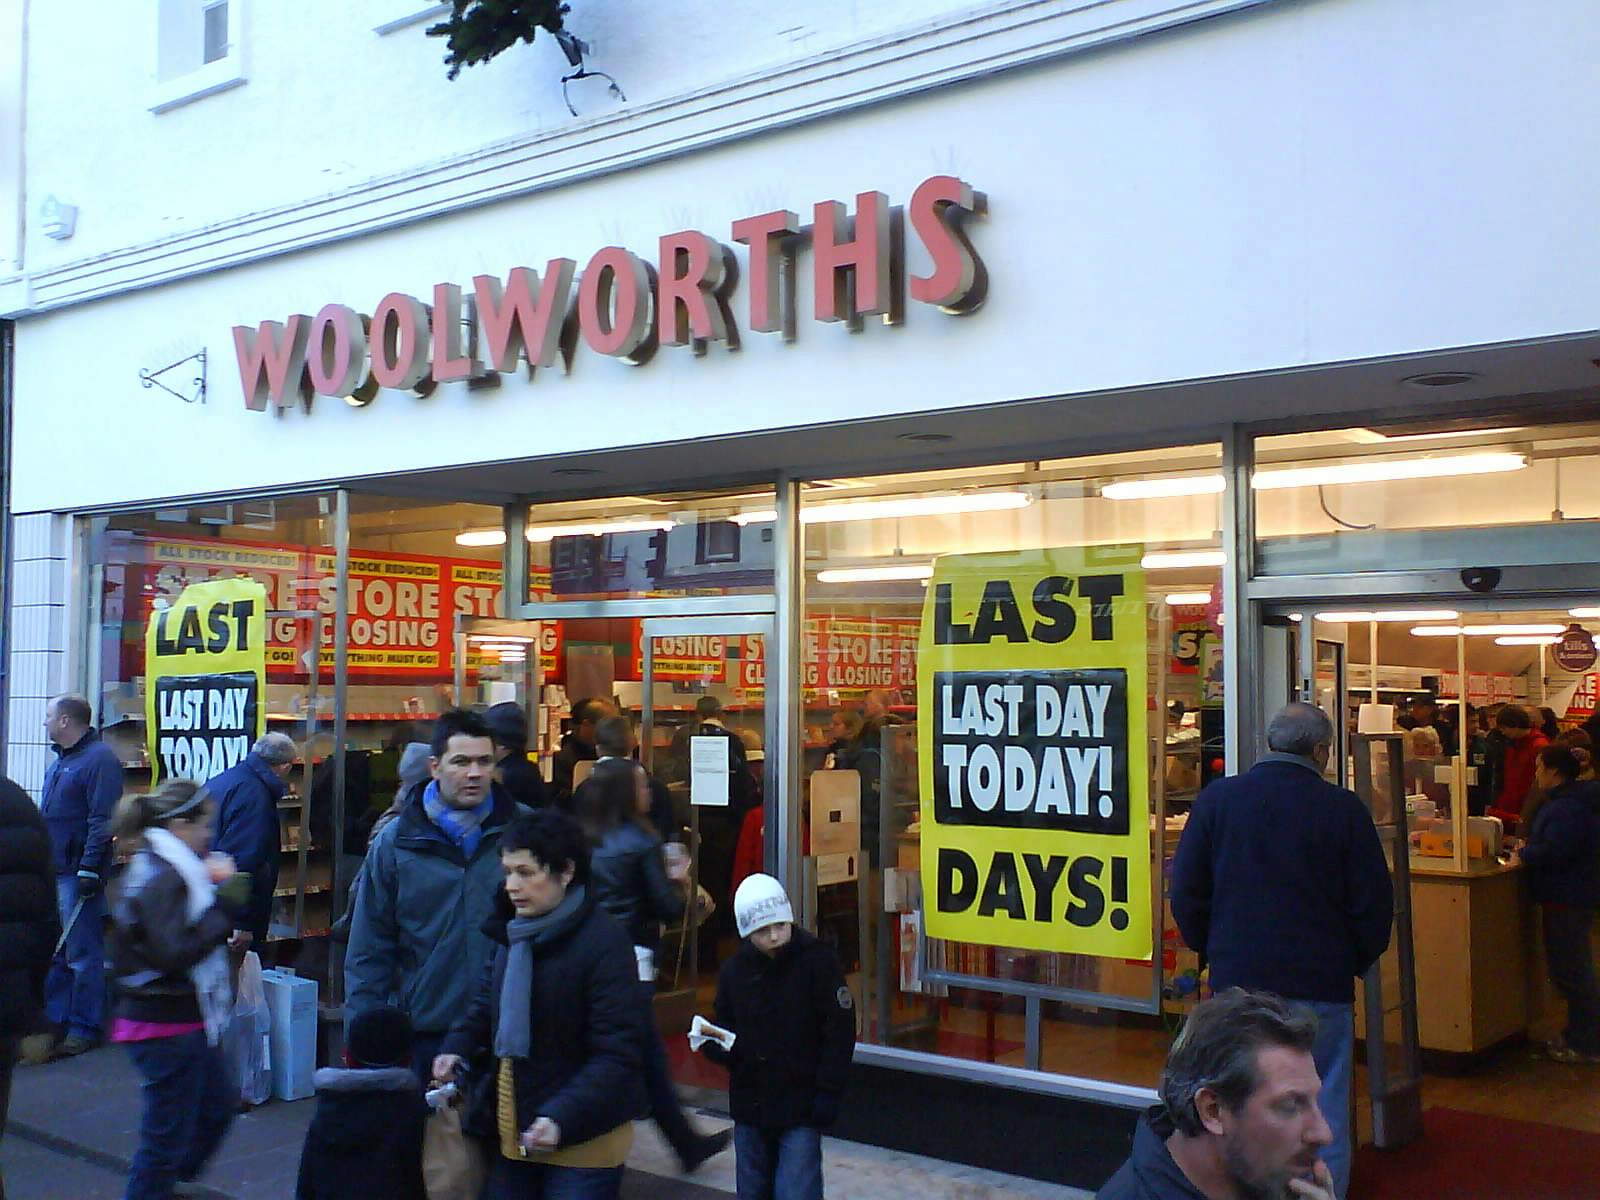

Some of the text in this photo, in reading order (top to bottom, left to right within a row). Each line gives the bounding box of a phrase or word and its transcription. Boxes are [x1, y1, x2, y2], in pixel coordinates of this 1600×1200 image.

[232, 175, 986, 414] WOOLWORTHS
[317, 577, 440, 618] STORE
[934, 574, 1124, 645] LAST
[156, 600, 254, 656] LAST
[320, 617, 439, 647] COSING
[827, 636, 893, 664] STORE
[272, 651, 294, 661] GO!
[827, 666, 893, 685] CLOSING
[160, 688, 249, 731] LAST DAY
[943, 685, 1112, 738] LAST DAY
[943, 743, 1113, 819] TODAY!
[937, 847, 1130, 931] DAYS!
